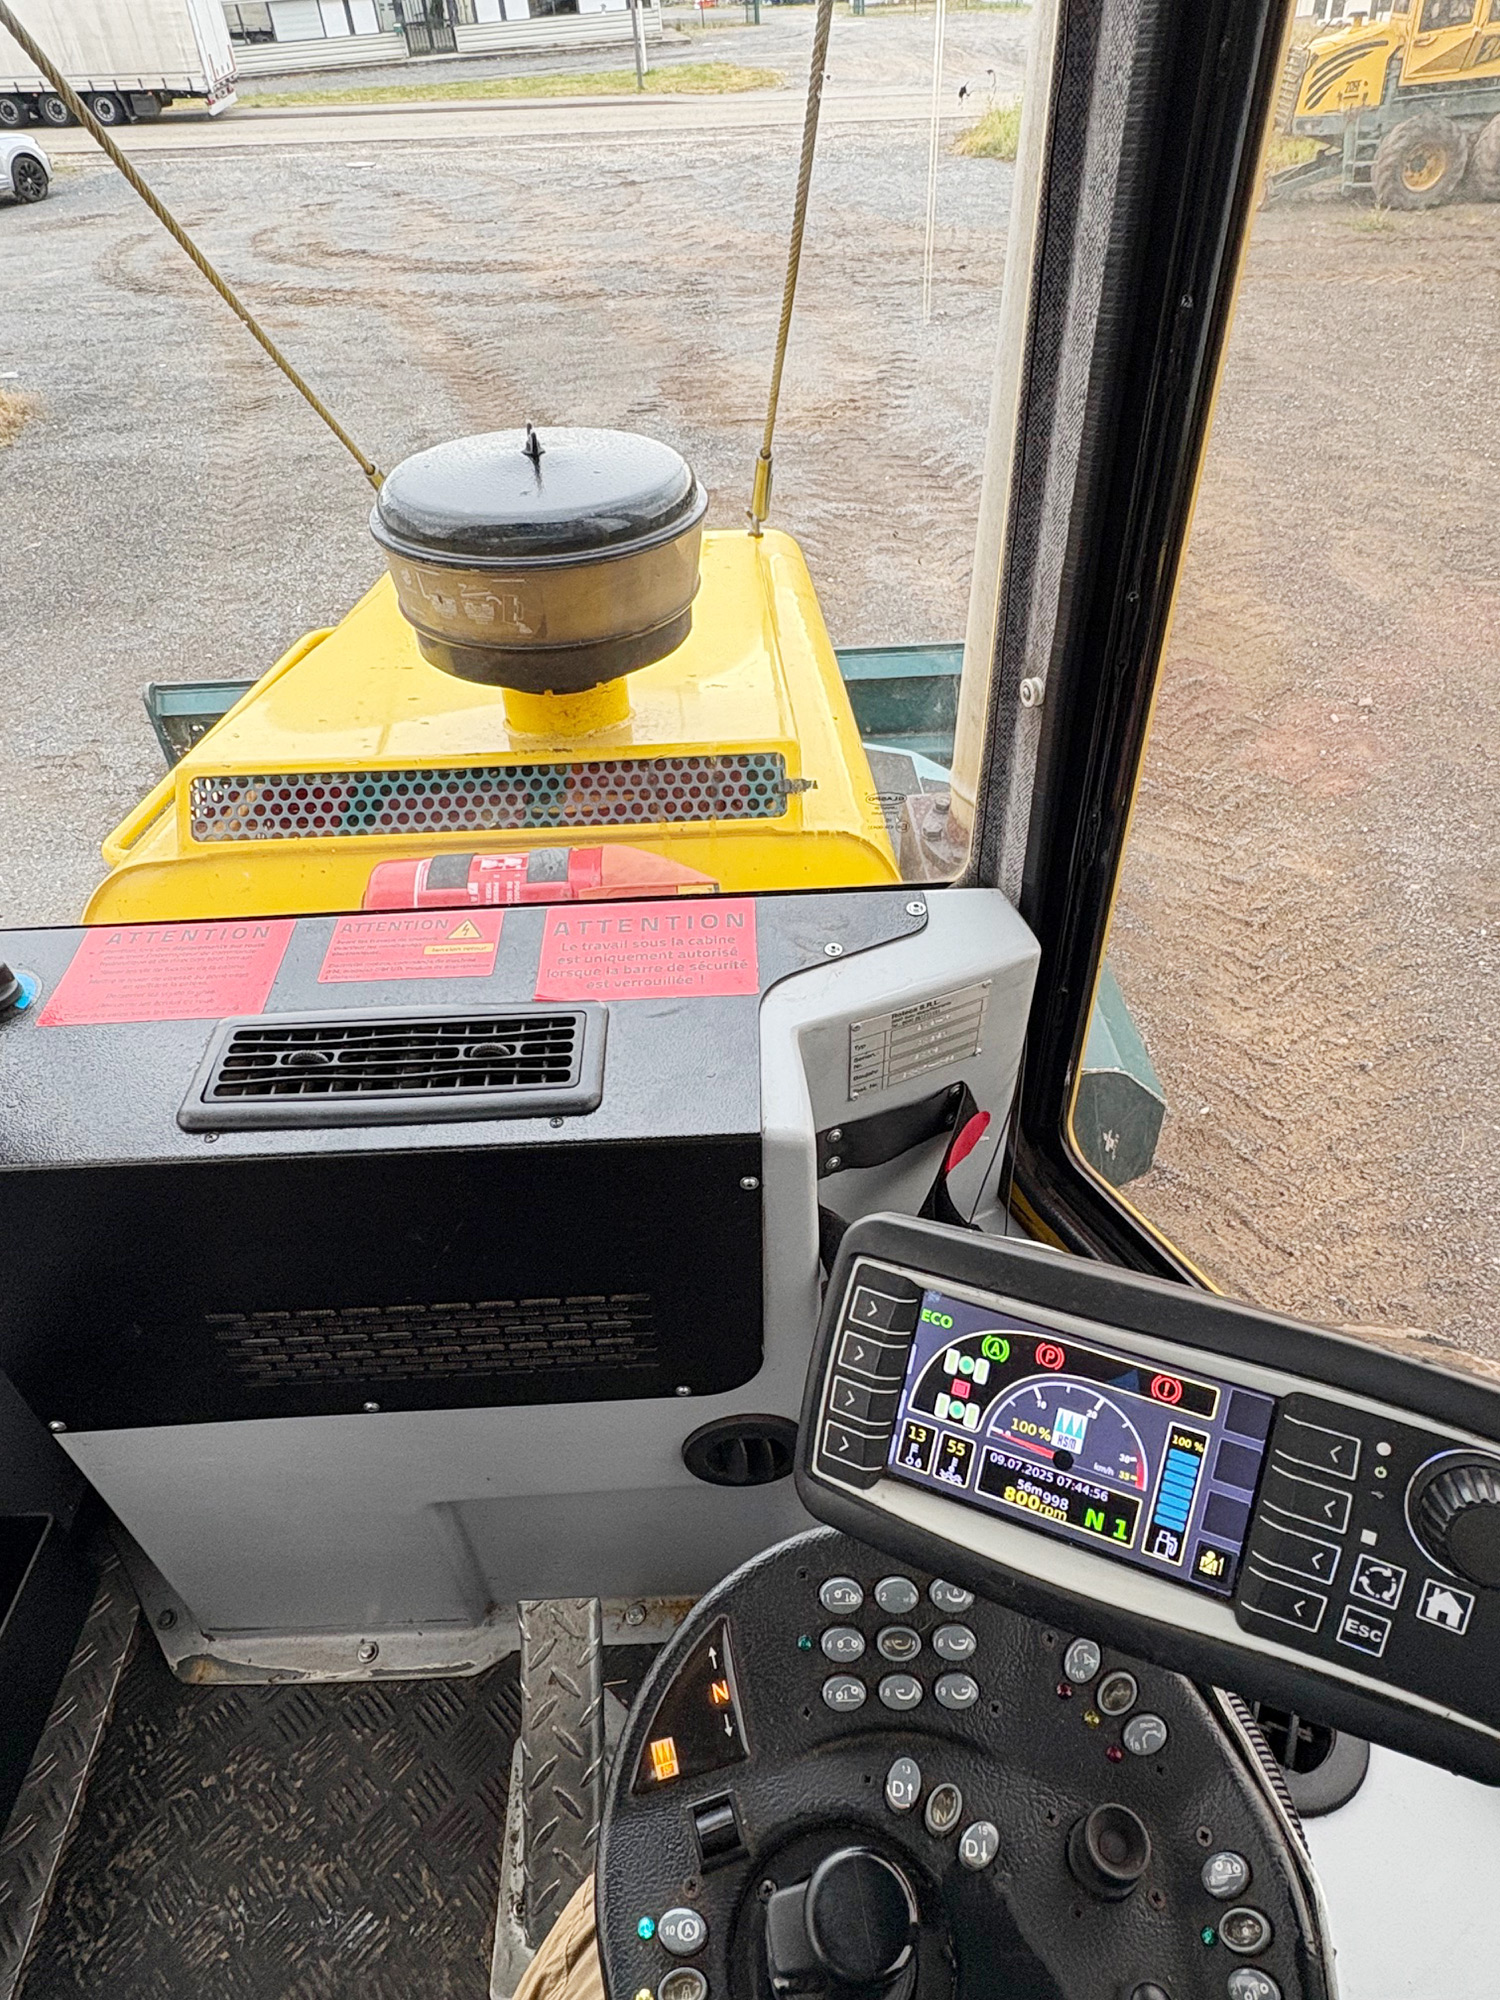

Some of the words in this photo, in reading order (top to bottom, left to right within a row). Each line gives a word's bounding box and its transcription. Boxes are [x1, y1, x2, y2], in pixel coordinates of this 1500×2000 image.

[340, 919, 450, 934] ATTENTION
[553, 913, 744, 936] ATTENTION
[105, 926, 271, 945] ATTENTION
[562, 942, 577, 952] Le
[582, 940, 628, 951] travail
[632, 938, 666, 949] sous
[672, 937, 684, 947] la
[688, 935, 736, 946] cabine
[557, 955, 581, 965] est
[584, 951, 674, 966] uniquement
[677, 947, 738, 959] autorisé
[546, 967, 601, 980] lorsque
[606, 965, 619, 975] la
[623, 963, 663, 974] barre
[667, 961, 685, 972] de
[689, 959, 748, 971] sécurité
[586, 979, 609, 989] est
[614, 975, 694, 988] verrouillée
[920, 1308, 954, 1329] ECO
[1036, 1398, 1047, 1410] 10
[1086, 1409, 1098, 1420] 20
[908, 1426, 927, 1443] 13
[946, 1440, 967, 1457] 55
[989, 1452, 1054, 1484] 09.07.2025
[1056, 1474, 1109, 1502] 07:44:56
[1093, 1461, 1115, 1477] km/h
[1084, 1508, 1105, 1532] N
[1112, 1518, 1128, 1541] 1
[881, 1592, 887, 1601] 2
[936, 1591, 942, 1600] 3
[1344, 1618, 1383, 1643] ESC
[711, 1680, 729, 1703] N
[892, 1780, 904, 1797] D
[965, 1840, 978, 1857] D
[665, 1925, 675, 1935] 10
